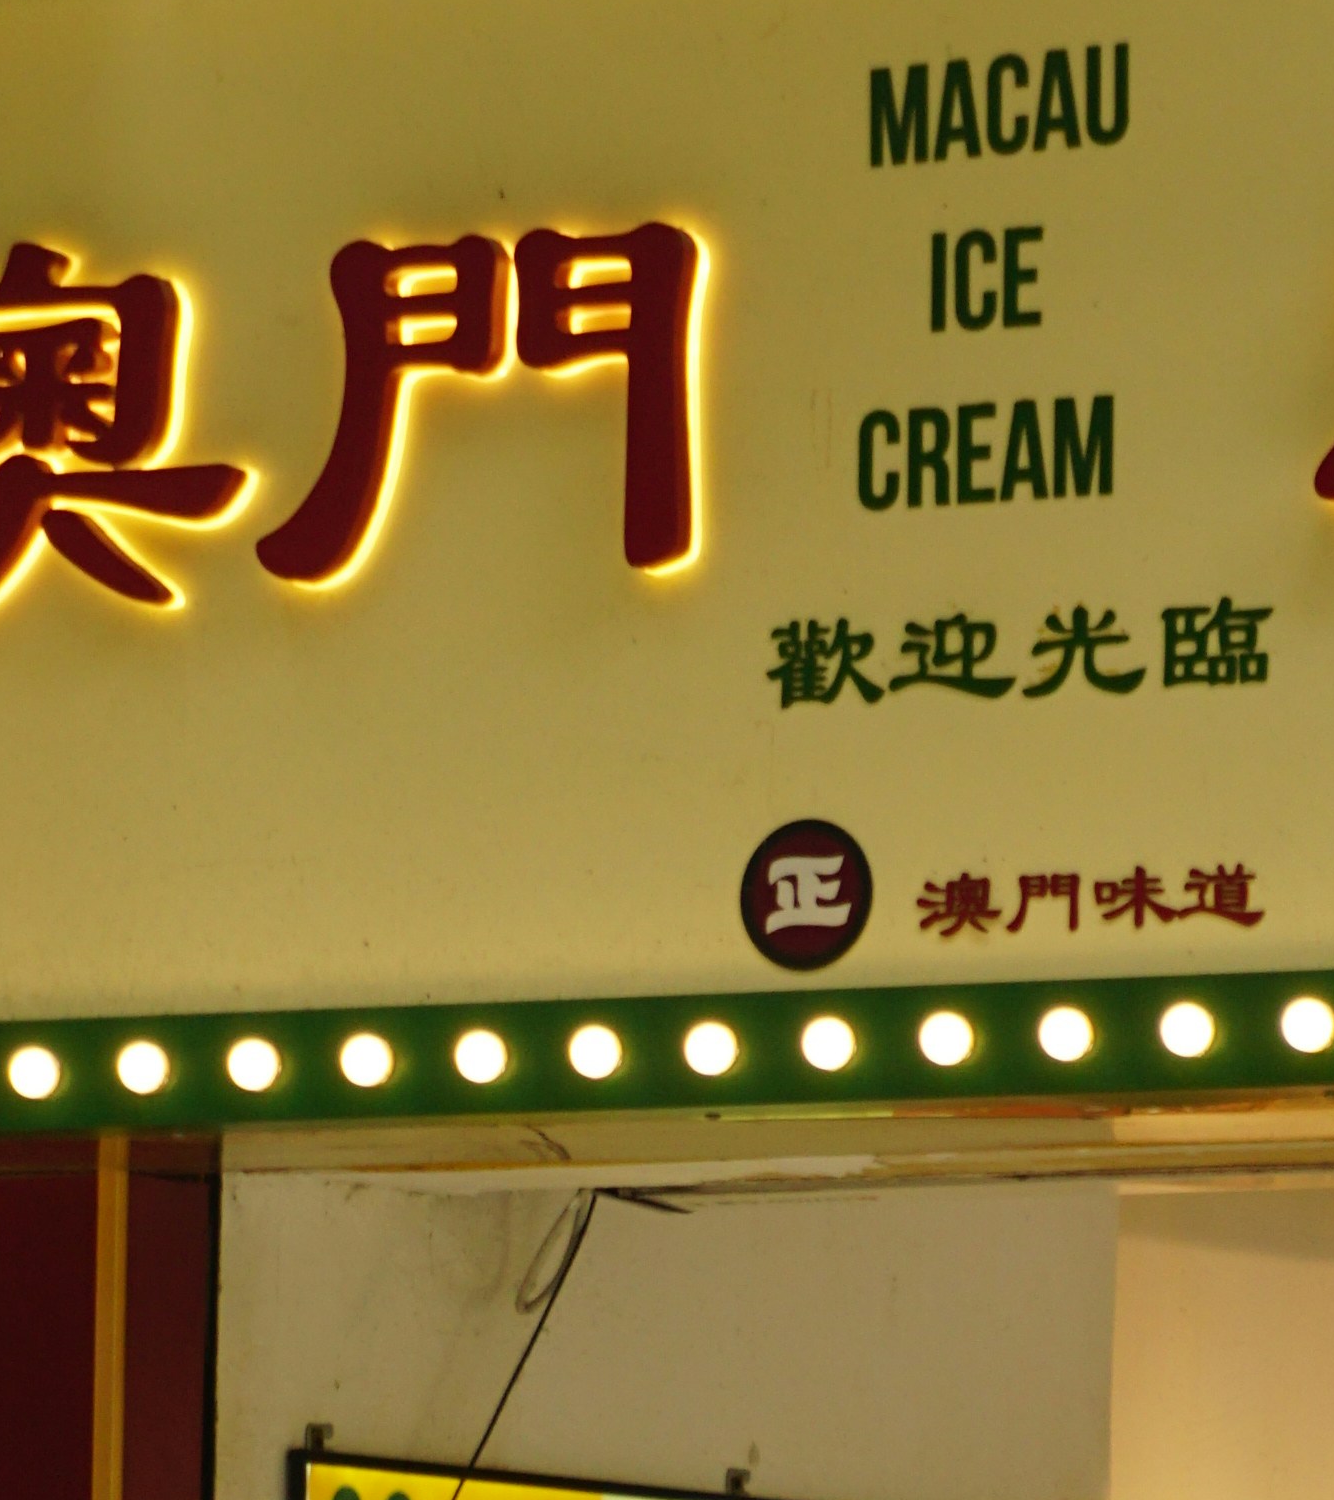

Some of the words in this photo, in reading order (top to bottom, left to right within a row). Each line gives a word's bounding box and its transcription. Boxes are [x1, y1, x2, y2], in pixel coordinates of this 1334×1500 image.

[868, 42, 1132, 168] MACAU
[929, 225, 1044, 334] ICE
[855, 395, 1116, 513] CREAM
[767, 597, 1273, 708] 歡迎光臨
[915, 862, 1265, 937] 澳門味道
